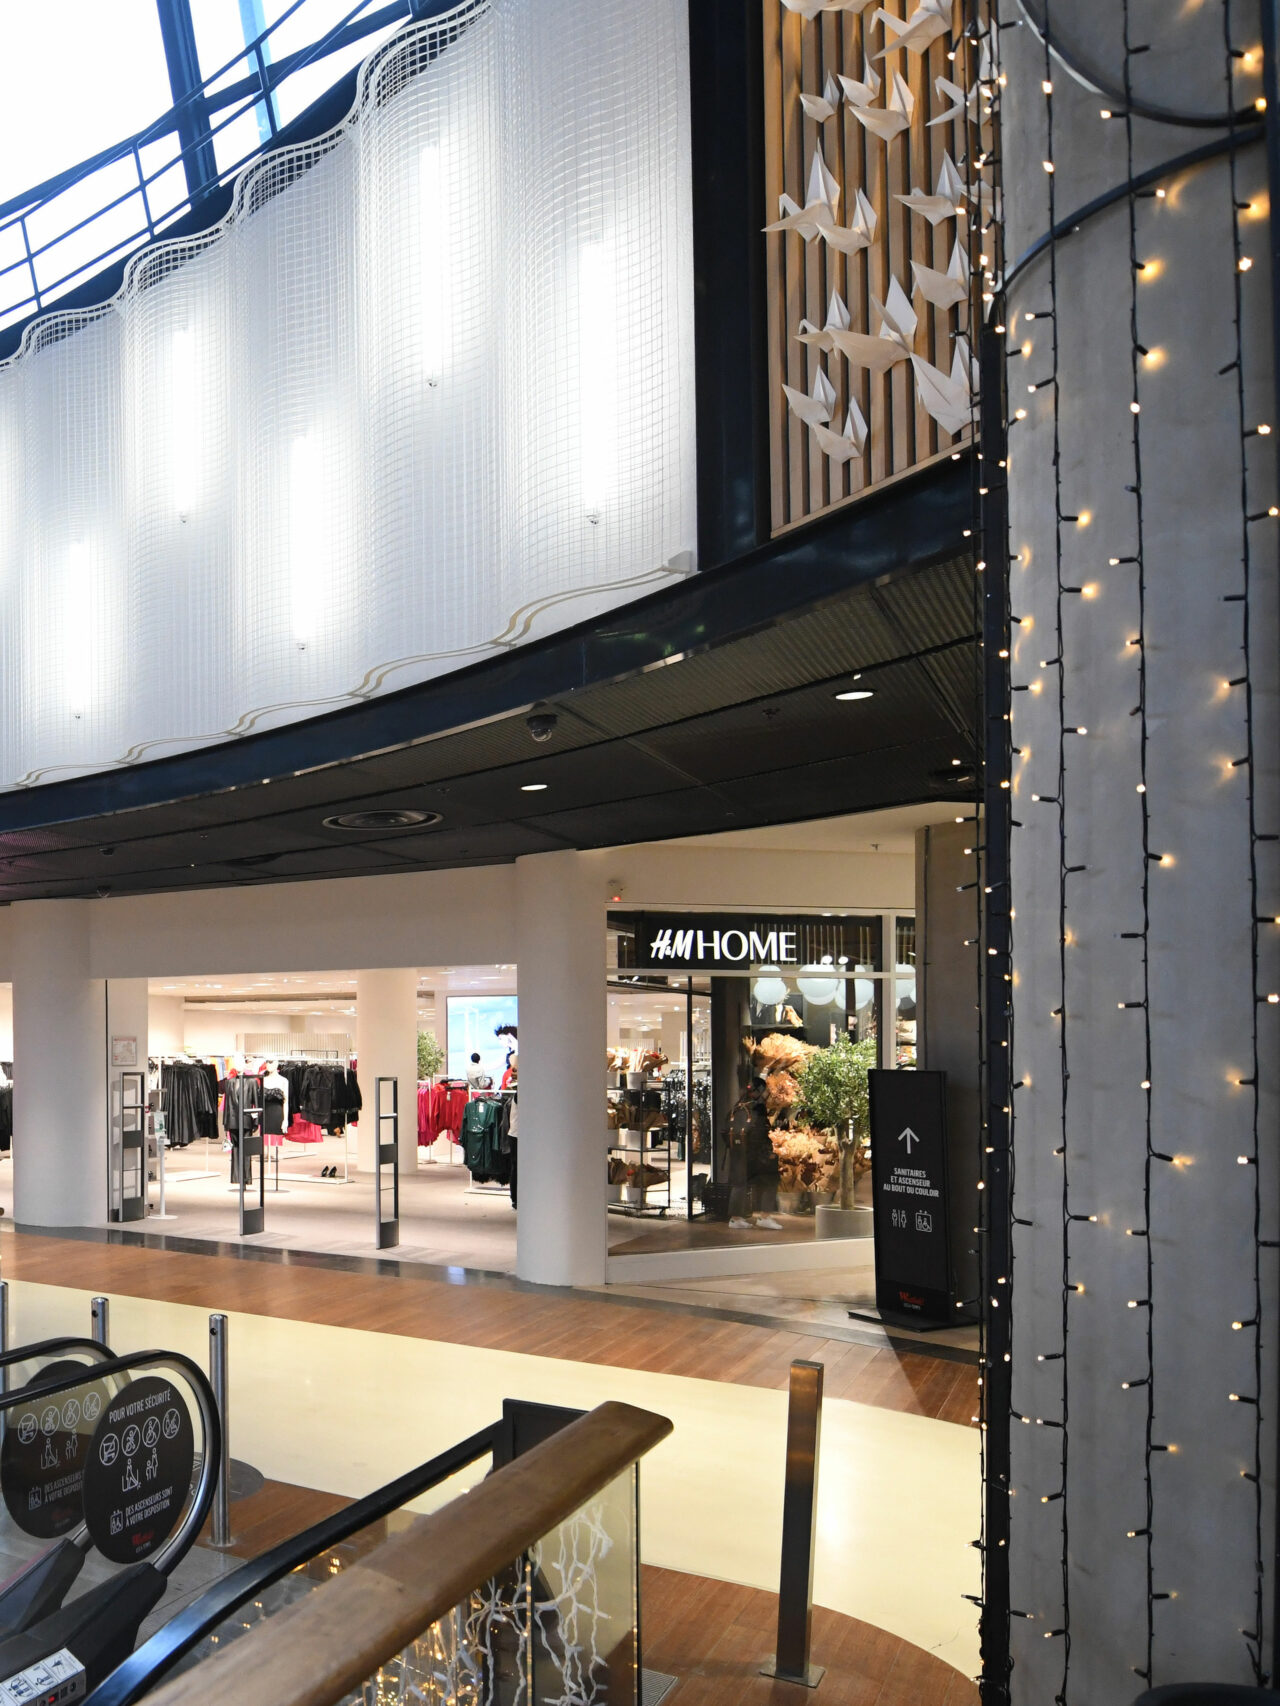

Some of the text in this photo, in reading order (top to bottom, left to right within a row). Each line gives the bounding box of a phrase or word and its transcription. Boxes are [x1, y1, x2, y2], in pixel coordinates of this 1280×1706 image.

[650, 929, 798, 961] H&M HOME
[894, 1168, 927, 1178] SANITAIRES
[898, 1177, 931, 1187] ASCENSEUR
[907, 1186, 914, 1194] DU
[915, 1187, 939, 1197] COULOIR
[109, 1386, 171, 1424] POUR VOTRE SÉCURITÉ
[125, 1486, 173, 1516] DES ASCENSEURS SONT
[130, 1510, 144, 1525] VOTRE
[143, 1499, 170, 1519] DISPOSITION
